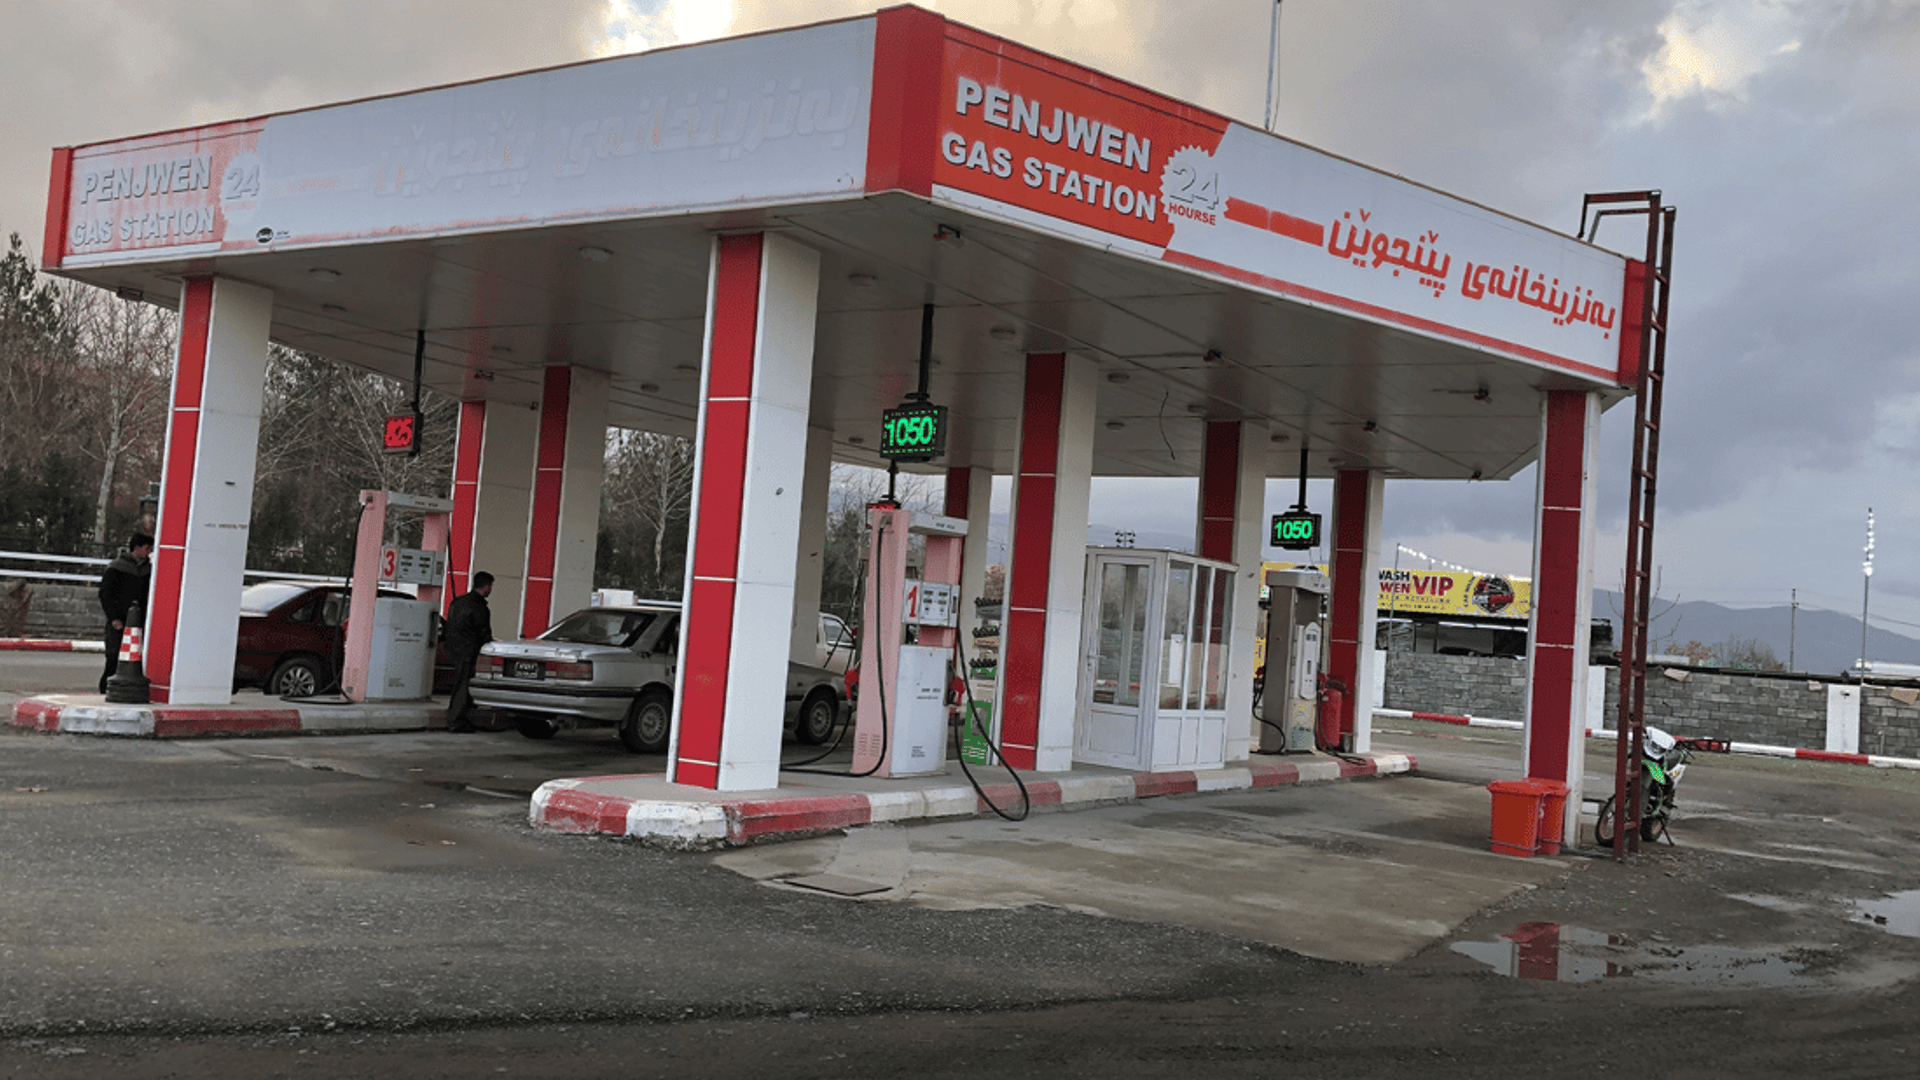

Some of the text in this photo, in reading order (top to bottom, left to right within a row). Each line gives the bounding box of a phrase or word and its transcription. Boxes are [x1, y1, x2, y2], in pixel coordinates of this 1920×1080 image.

[956, 75, 1151, 173] PENJWEN
[80, 156, 212, 205] PENJWEN
[225, 164, 260, 200] 24
[941, 131, 1157, 222] GAS STATION
[1170, 160, 1220, 210] 24
[72, 205, 215, 247] GAS STATION
[1168, 201, 1217, 226] HOURSE
[884, 416, 933, 446] 1050
[1274, 520, 1313, 539] 1050
[385, 551, 395, 576] 3
[908, 585, 918, 618] 1
[1412, 574, 1454, 596] VIP
